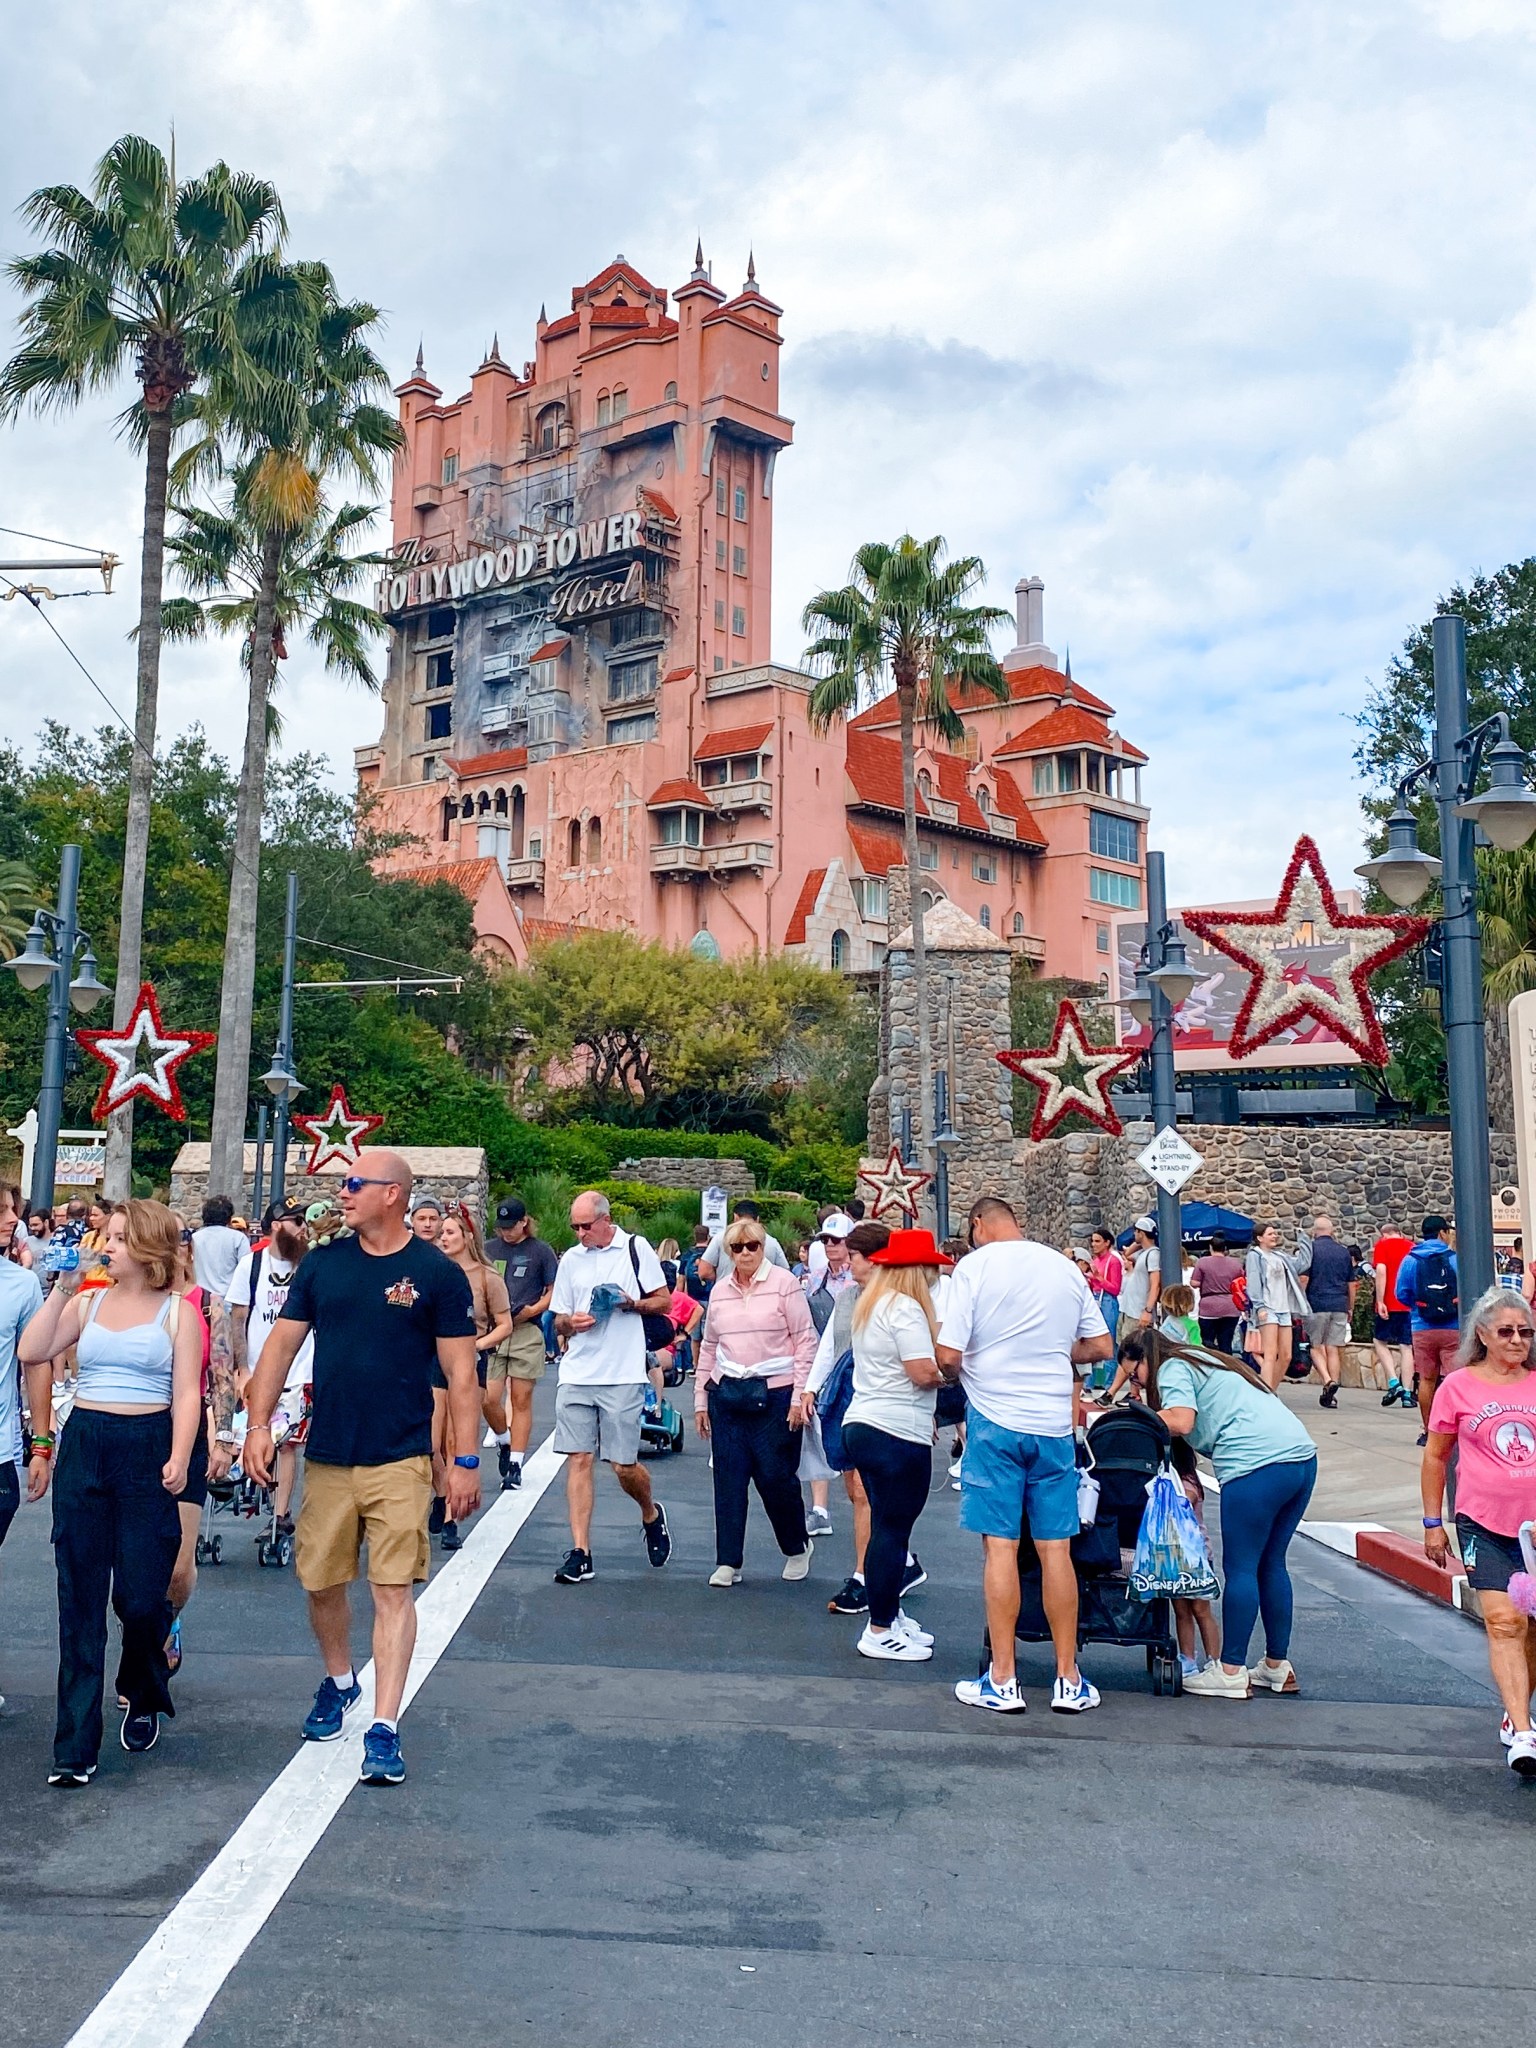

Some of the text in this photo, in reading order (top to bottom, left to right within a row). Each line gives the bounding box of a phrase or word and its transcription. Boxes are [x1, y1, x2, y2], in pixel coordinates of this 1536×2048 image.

[374, 510, 647, 614] HOLLYWOOD TOWER
[393, 535, 437, 567] The
[545, 561, 645, 622] Hotel
[56, 1159, 104, 1175] OOPS
